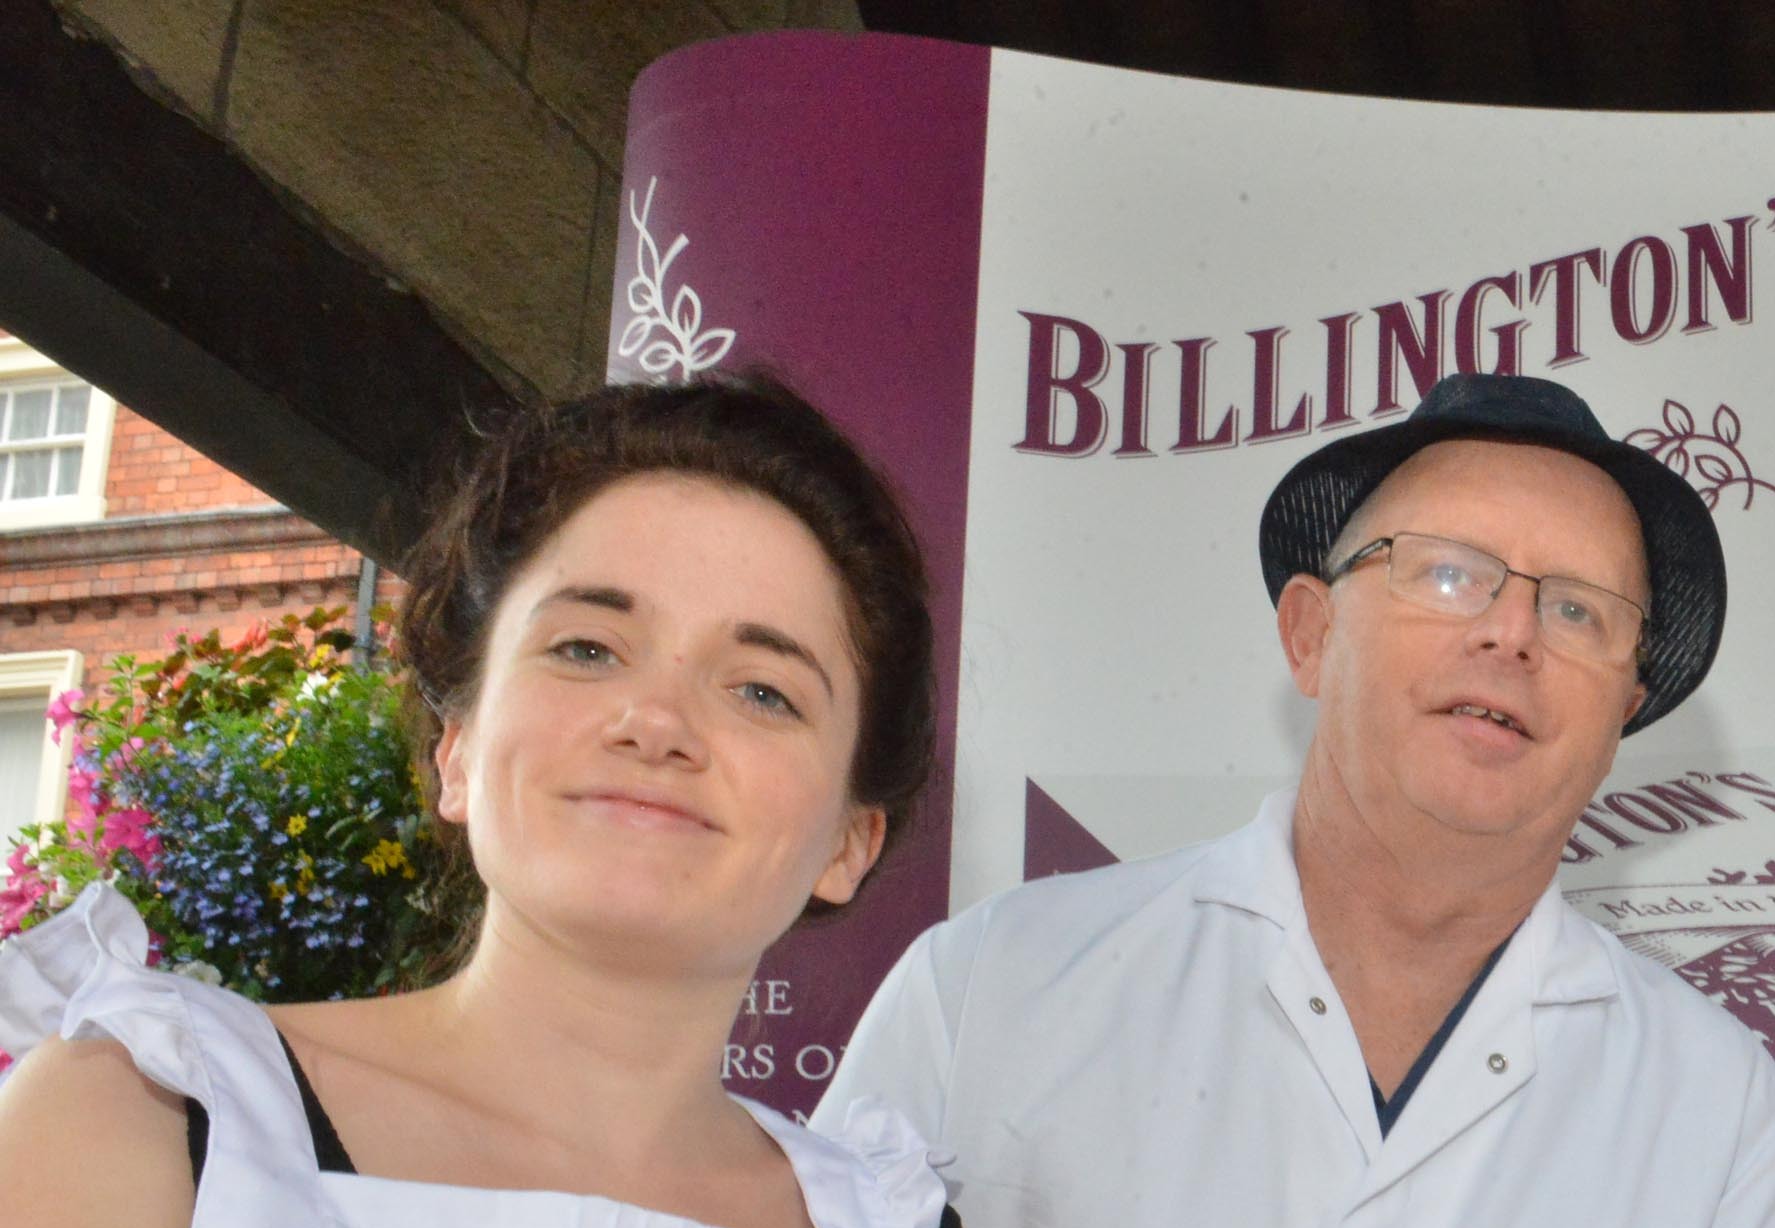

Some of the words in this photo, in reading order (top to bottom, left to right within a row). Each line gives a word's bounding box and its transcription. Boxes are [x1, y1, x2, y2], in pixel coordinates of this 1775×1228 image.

[1600, 896, 1713, 920] Made
[1714, 895, 1763, 913] in
[795, 1044, 849, 1080] O
